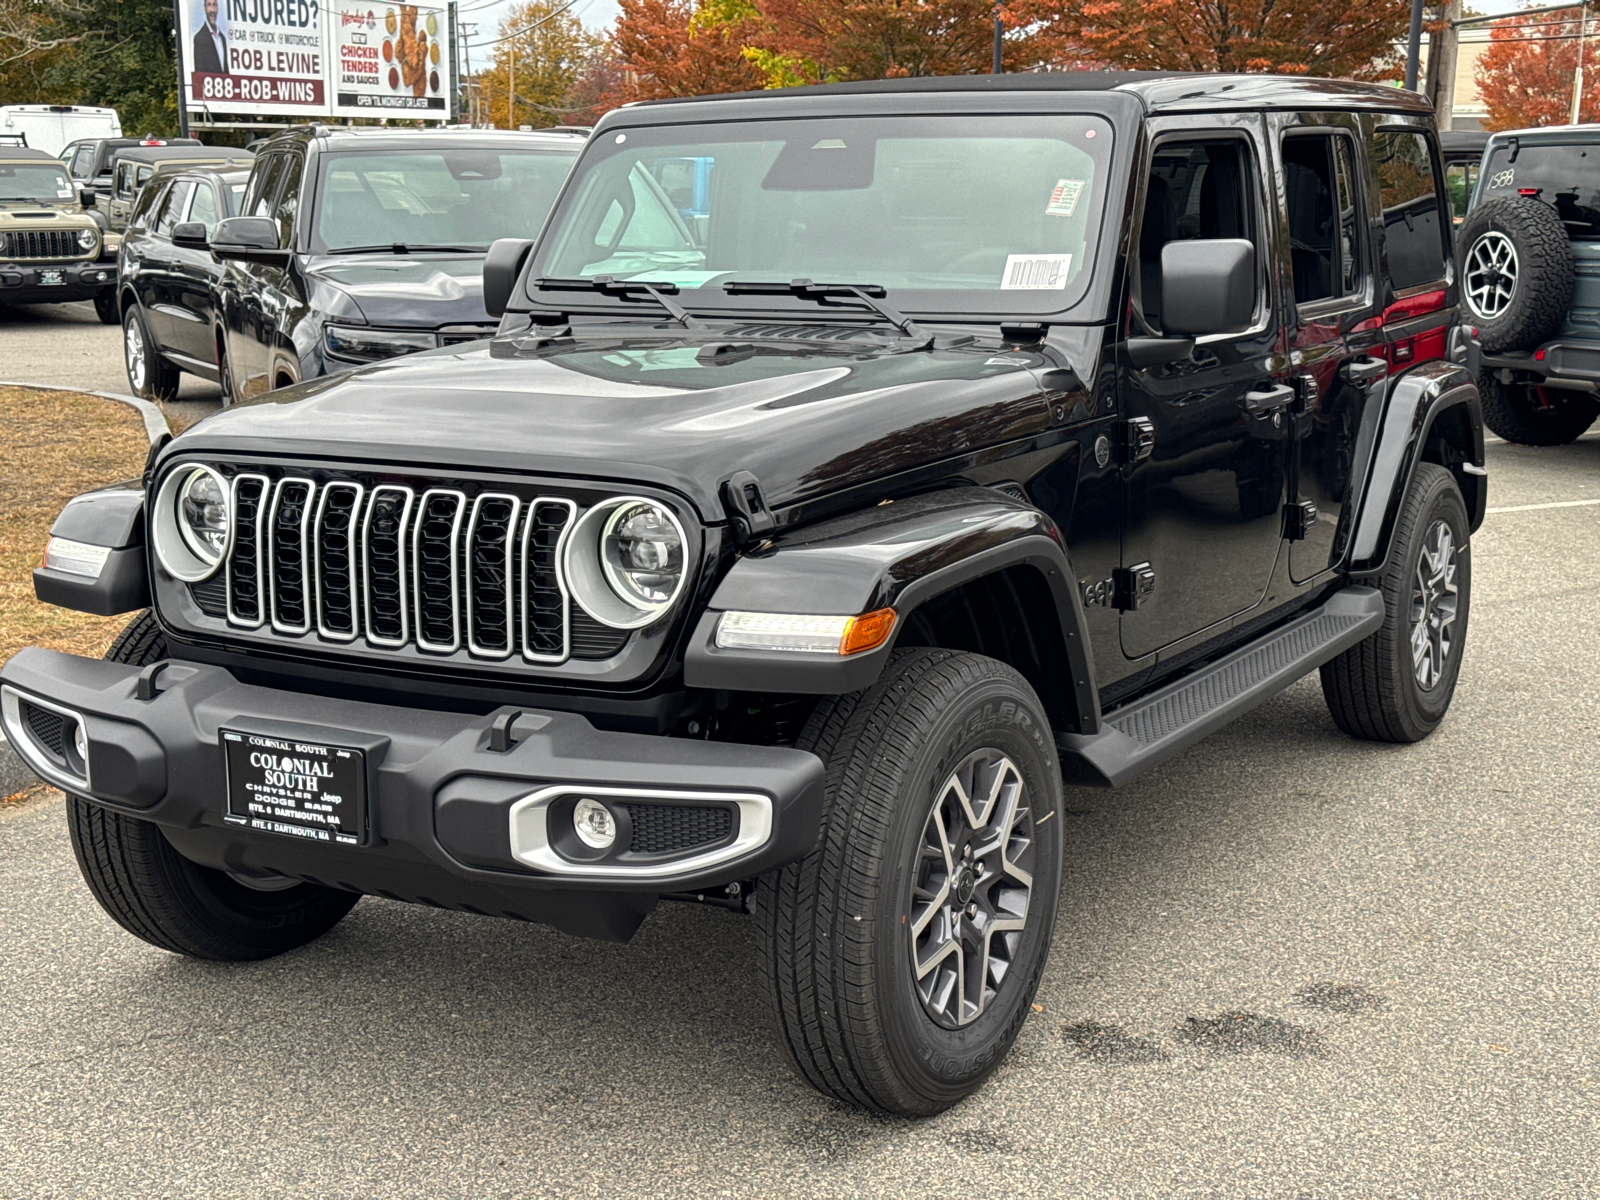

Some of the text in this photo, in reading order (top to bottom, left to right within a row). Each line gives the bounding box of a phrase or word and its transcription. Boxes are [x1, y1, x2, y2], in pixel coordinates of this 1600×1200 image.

[234, 29, 319, 47] CAR TRUCK MOTORCYCLE
[230, 48, 320, 74] ROB LEVINE
[341, 45, 379, 60] CHICKEN
[341, 60, 379, 74] TENDERS
[203, 76, 315, 102] 888-ROB-WINS
[342, 75, 380, 86] AND SAUCES
[357, 95, 372, 106] OPEN
[381, 96, 406, 107] MIDNIGHT
[413, 98, 428, 108] LATER
[249, 736, 292, 751] COLONIAL
[295, 744, 327, 756] SOUTH
[250, 752, 334, 778] COLONIAL
[265, 770, 319, 792] SOUTH
[245, 783, 342, 804] CHRYSLER Jeep
[254, 793, 333, 812] DODGE RAM
[248, 803, 341, 825] RTE. 6 DARTMOUTH, MA
[251, 820, 330, 841] RTE. 6 DARTMOUTH, MA
